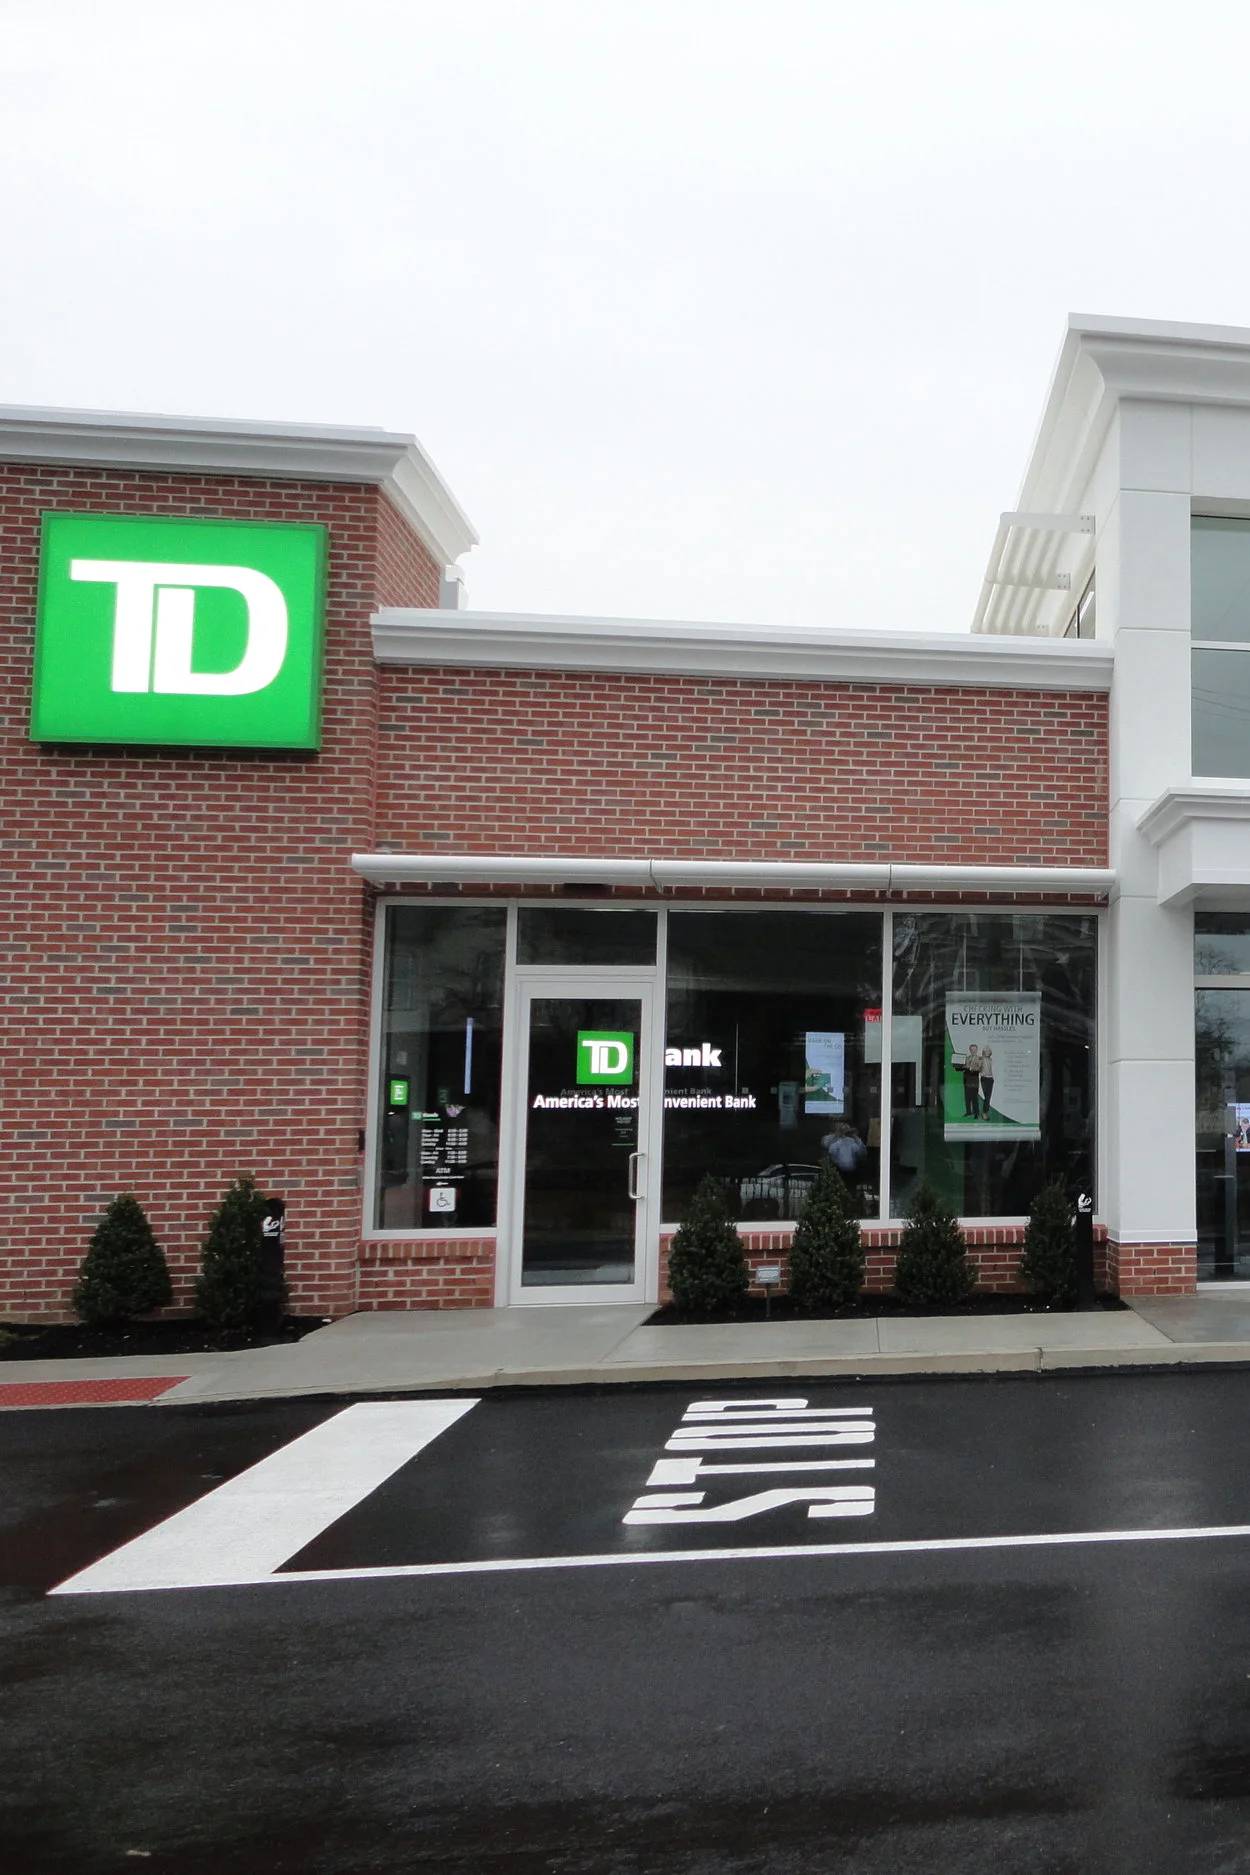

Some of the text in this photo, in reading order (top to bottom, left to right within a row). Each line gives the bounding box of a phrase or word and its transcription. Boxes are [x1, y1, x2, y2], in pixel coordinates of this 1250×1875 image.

[70, 559, 288, 697] TD
[951, 1013, 1035, 1026] EVERYTHING
[963, 1004, 1003, 1013] CHECKING
[582, 1040, 722, 1074] TD ank
[532, 1095, 604, 1109] America's
[725, 1095, 757, 1109] Bank
[622, 1398, 876, 1526] STOP
